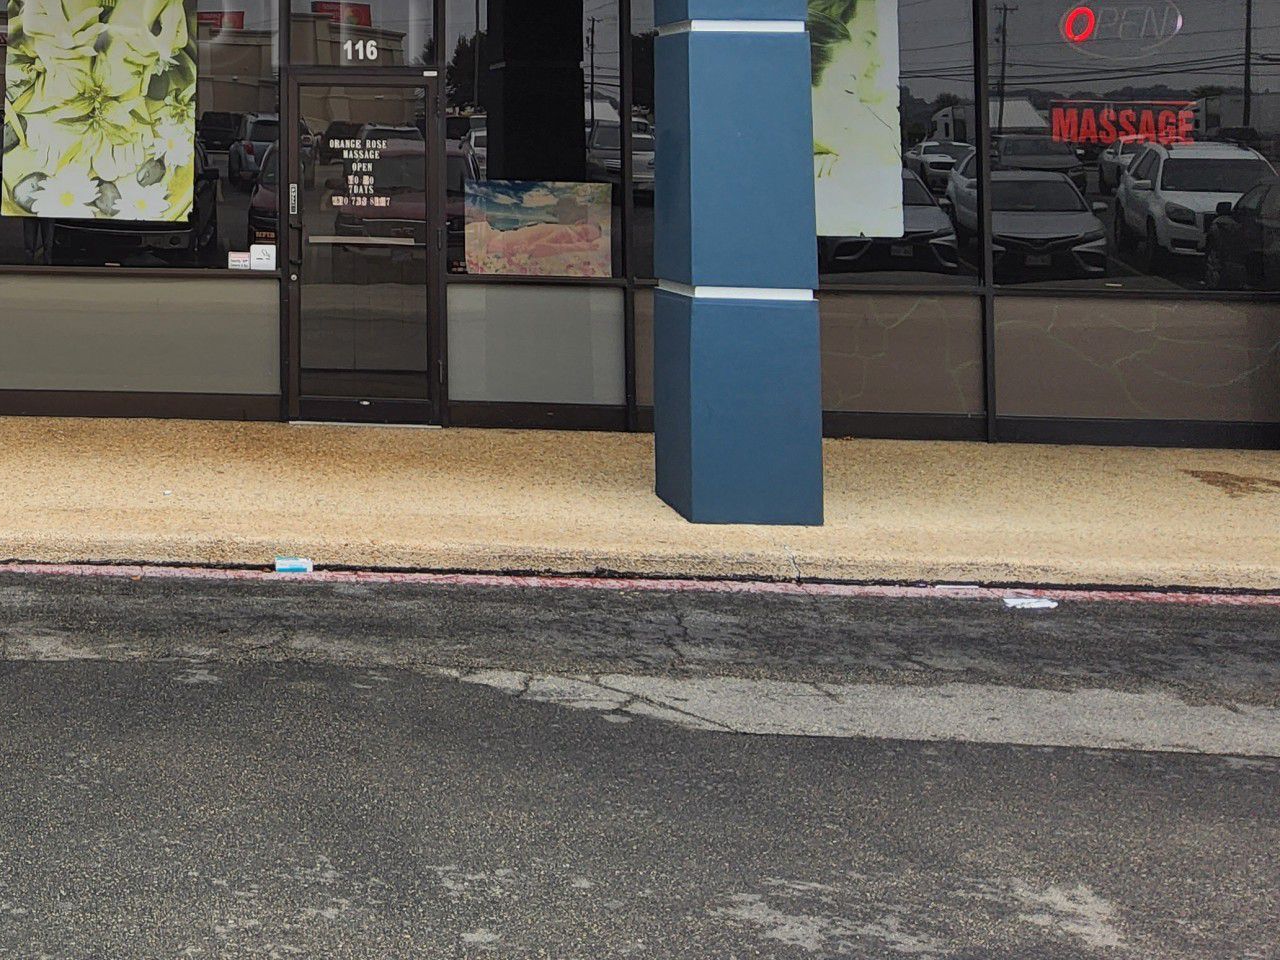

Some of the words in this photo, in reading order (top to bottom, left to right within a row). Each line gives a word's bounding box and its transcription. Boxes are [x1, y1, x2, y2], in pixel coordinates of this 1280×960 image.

[1065, 5, 1171, 44] OPEN
[343, 39, 378, 60] 116
[1051, 106, 1196, 146] MASSAGE
[329, 139, 362, 149] ORANGE
[366, 139, 387, 149] ROSE
[343, 150, 380, 159] MASSAGE
[351, 163, 373, 172] OPEN
